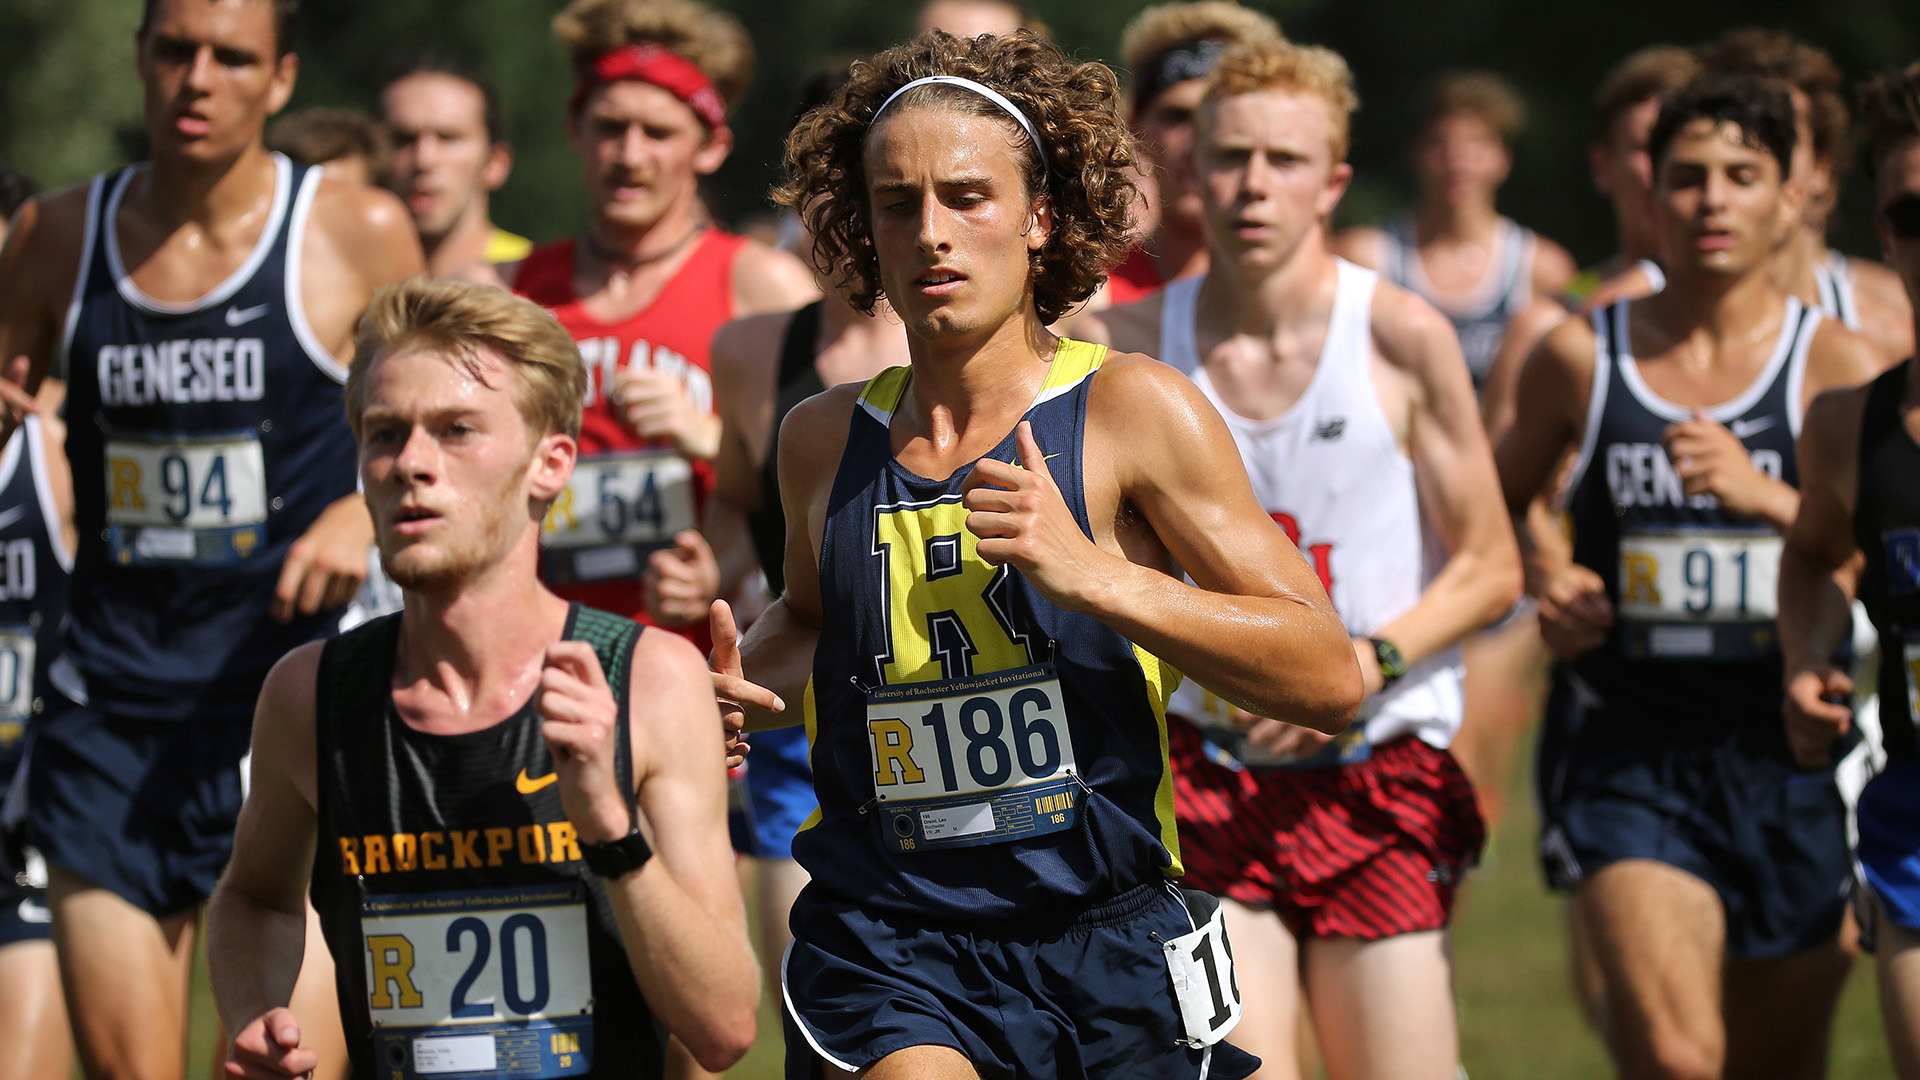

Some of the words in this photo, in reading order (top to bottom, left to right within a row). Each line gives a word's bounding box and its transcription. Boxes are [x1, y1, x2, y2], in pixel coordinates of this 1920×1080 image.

[98, 338, 265, 404] GENESEO
[110, 457, 146, 510] R
[161, 454, 232, 523] 94
[543, 486, 578, 533] R
[597, 469, 664, 537] 54
[872, 494, 1034, 686] R
[1622, 553, 1661, 605] R
[1683, 549, 1749, 616] 91
[874, 689, 905, 699] University
[906, 687, 913, 696] of
[914, 685, 949, 696] Rochester
[949, 677, 998, 691] Yellowjacket
[999, 668, 1045, 684] Invitational
[868, 717, 926, 787] R
[921, 687, 1061, 793] 186
[339, 821, 582, 875] BROCKPOR
[899, 838, 916, 850] 186
[1050, 812, 1065, 825] 186
[366, 933, 424, 1009] R
[446, 913, 551, 1019] 20
